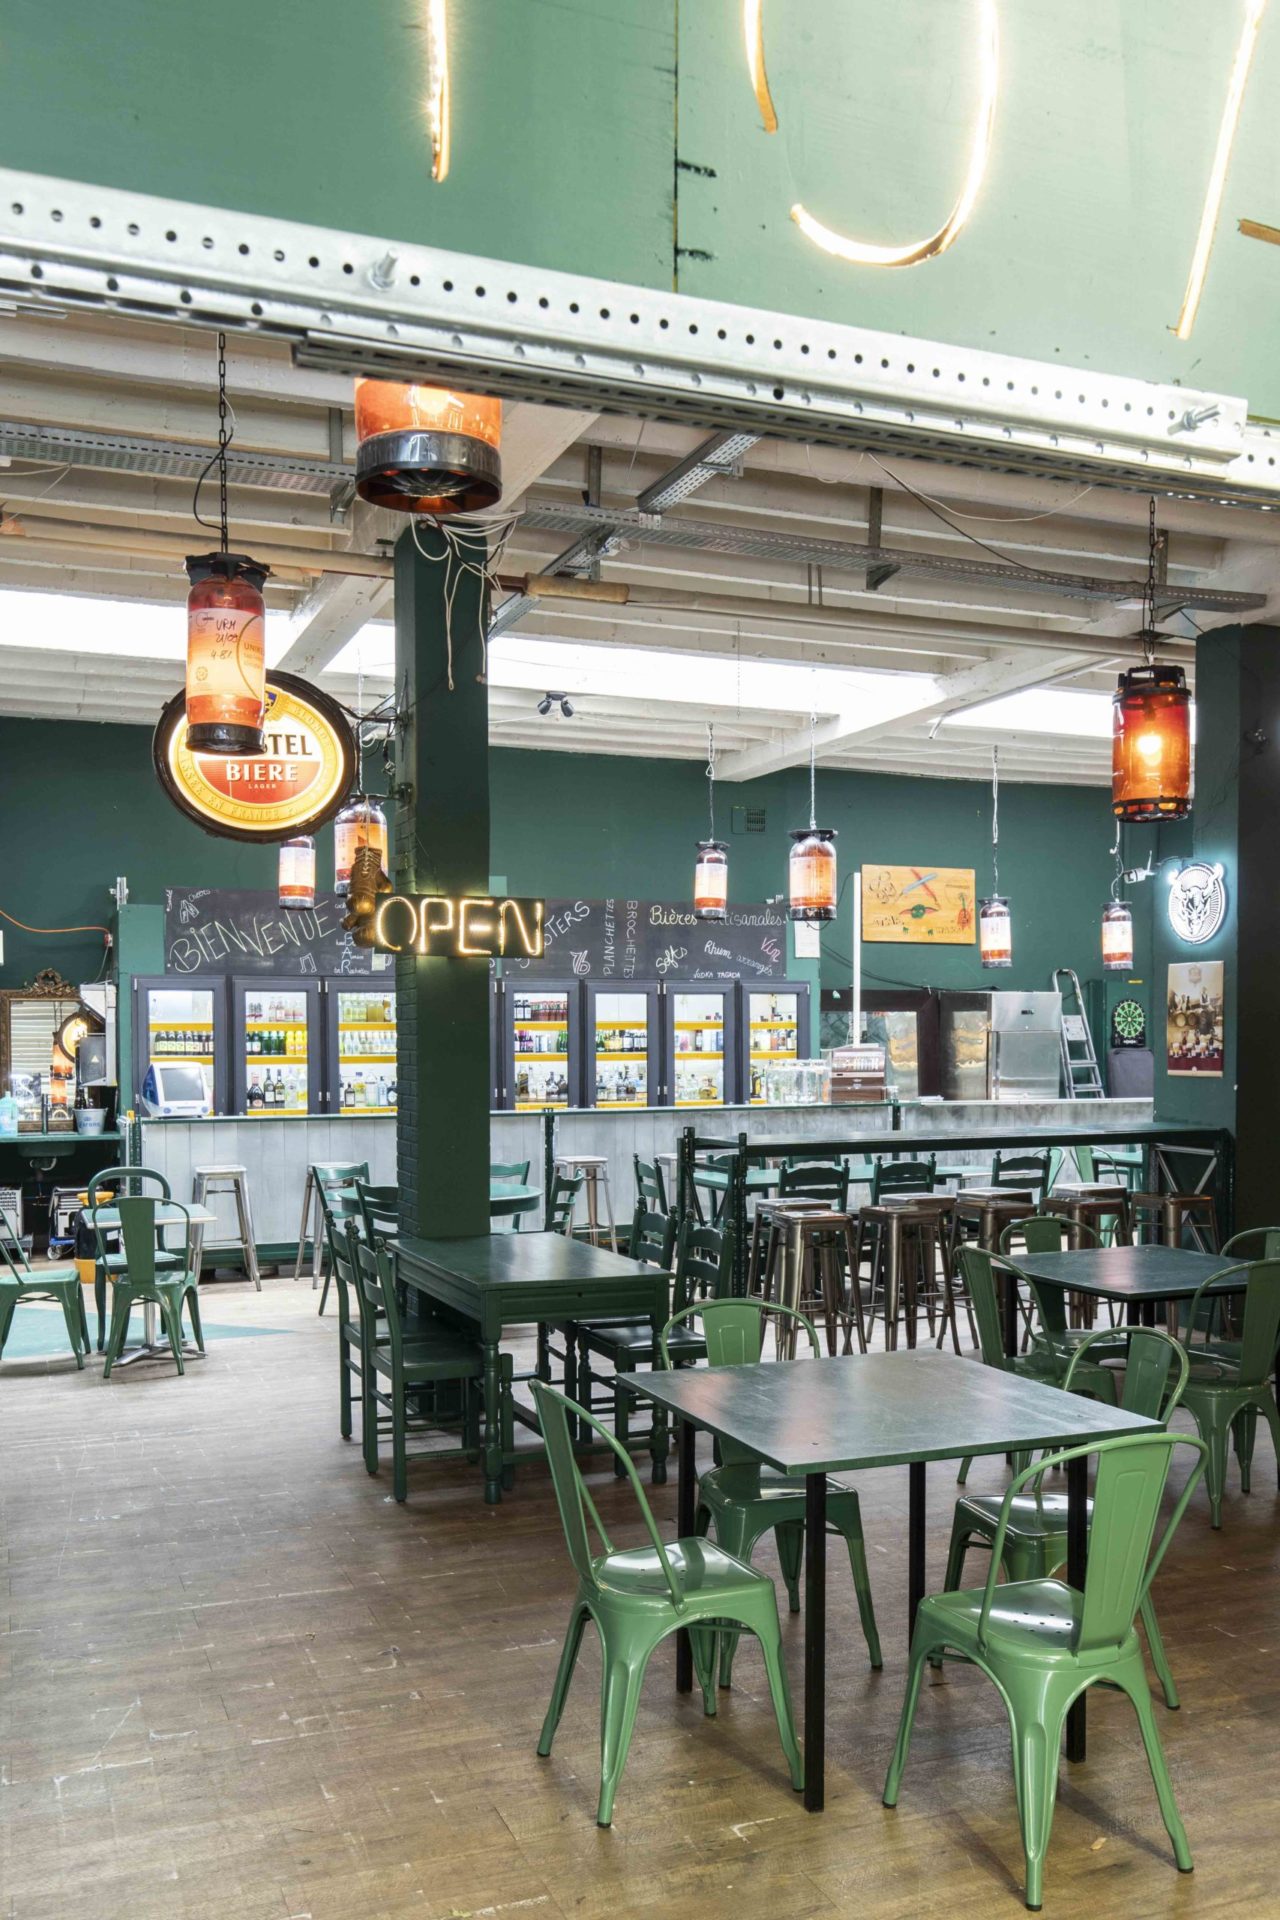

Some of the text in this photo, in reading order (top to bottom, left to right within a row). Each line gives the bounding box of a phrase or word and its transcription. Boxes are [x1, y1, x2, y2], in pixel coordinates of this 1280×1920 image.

[226, 763, 299, 782] BIERE
[376, 896, 541, 956] OPEN
[649, 904, 698, 926] Bières
[169, 900, 337, 973] BIENVENUE
[602, 898, 615, 976] PLANCHETTES
[623, 900, 638, 979] BROCHETTES
[760, 937, 782, 963] Vin
[655, 945, 688, 974] Softs
[704, 940, 773, 977] Rhum arrangés
